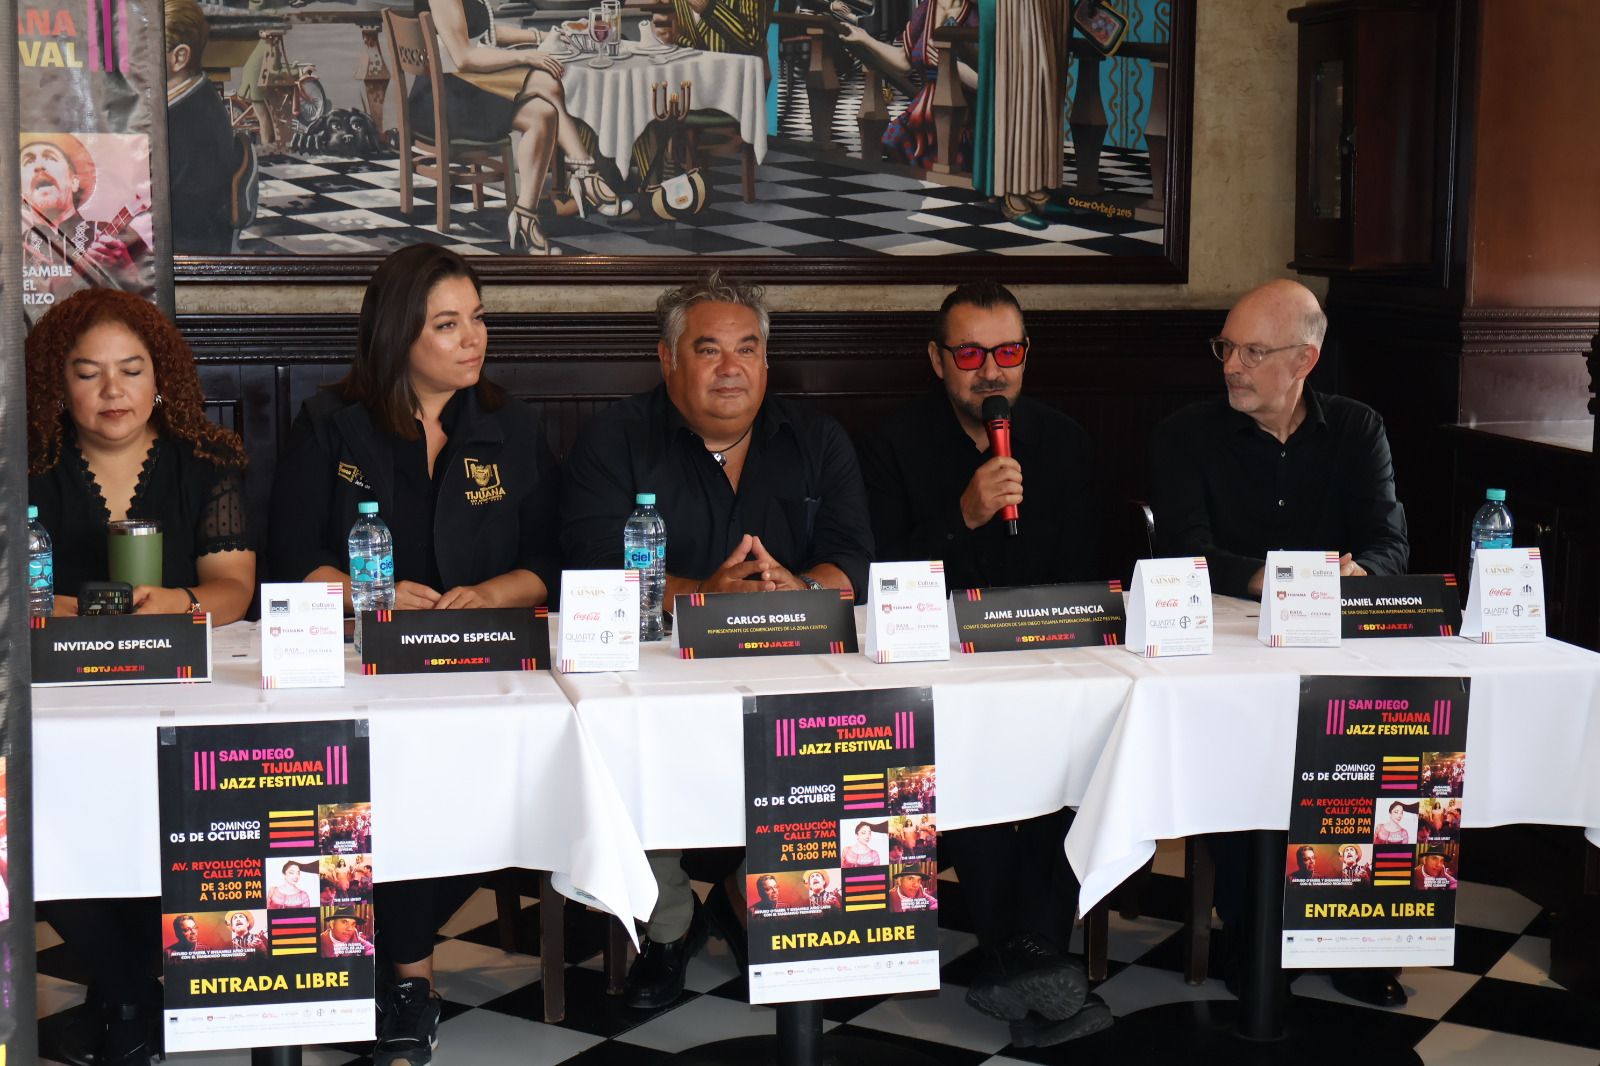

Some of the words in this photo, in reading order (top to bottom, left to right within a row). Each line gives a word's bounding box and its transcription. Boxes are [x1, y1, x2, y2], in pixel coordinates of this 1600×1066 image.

[465, 487, 507, 500] TIJUANA
[632, 552, 651, 562] ciel
[1341, 598, 1373, 607] DANIEL
[1375, 596, 1422, 606] ATKINSON
[984, 610, 1013, 620] JAIME
[1015, 608, 1050, 618] JULIAN
[1052, 604, 1105, 616] PLACENCIA
[726, 615, 766, 625] CARLOS
[769, 613, 806, 623] ROBLES
[401, 633, 460, 645] INVITADO
[463, 632, 516, 643] ESPECIAL
[566, 632, 596, 640] QUARTZ
[54, 640, 115, 652] INVITADO
[118, 638, 172, 650] ESPECIAL
[1348, 700, 1372, 710] SAN
[1375, 700, 1409, 710] DIEGO
[798, 717, 826, 729] SAN
[828, 714, 866, 727] DIEGO
[1381, 712, 1431, 723] TIJUANA
[836, 726, 893, 740] TIJUANA
[1346, 725, 1376, 735] JAZZ
[1378, 725, 1430, 735] FESTIVAL
[799, 742, 832, 756] JAZZ
[835, 739, 893, 753] FESTIVAL
[219, 749, 249, 762] SAN
[252, 747, 295, 760] DIEGO
[261, 760, 324, 774] TIJUANA
[1335, 764, 1376, 772] DOMINGO
[219, 776, 256, 790] JAZZ
[259, 774, 324, 788] FESTIVAL
[1302, 772, 1314, 781] 05
[1318, 772, 1329, 781] DE
[1332, 772, 1375, 781] OCTUBRE
[790, 784, 836, 795] DOMINGO
[754, 797, 769, 807] 05
[772, 796, 785, 806] DE
[787, 793, 836, 805] OCTUBRE
[1316, 797, 1373, 806] REVOLUCIÓN
[211, 820, 261, 832] DOMINGO
[755, 825, 770, 834] AV.
[774, 819, 836, 833] REVOLUCIÓN
[1336, 818, 1355, 826] 3:00
[1358, 818, 1372, 826] PM
[784, 832, 811, 841] CALLE
[814, 830, 836, 839] 7MA
[1330, 826, 1355, 834] 10:00
[170, 832, 186, 844] 05
[189, 831, 204, 842] DE
[208, 830, 260, 841] OCTUBRE
[782, 844, 794, 853] DE
[797, 842, 819, 852] 3:00
[821, 841, 837, 850] PM
[780, 853, 788, 862] A
[792, 851, 819, 861] 10:00
[822, 850, 837, 859] PM
[172, 861, 189, 871] AV.
[192, 858, 262, 870] REVOLUCIÓN
[203, 870, 234, 879] CALLE
[237, 869, 262, 878] 7MA
[201, 882, 215, 892] DE
[218, 881, 239, 891] 3:00
[245, 881, 262, 890] PM
[199, 892, 208, 901] A
[212, 891, 242, 900] 10:00
[245, 890, 262, 899] PM
[1304, 903, 1386, 918] ENTRADA
[1391, 902, 1435, 917] LIBRE
[771, 929, 861, 951] ENTRADA
[867, 925, 915, 943] LIBRE
[190, 974, 289, 995] ENTRADA
[296, 971, 349, 989] LIBRE
